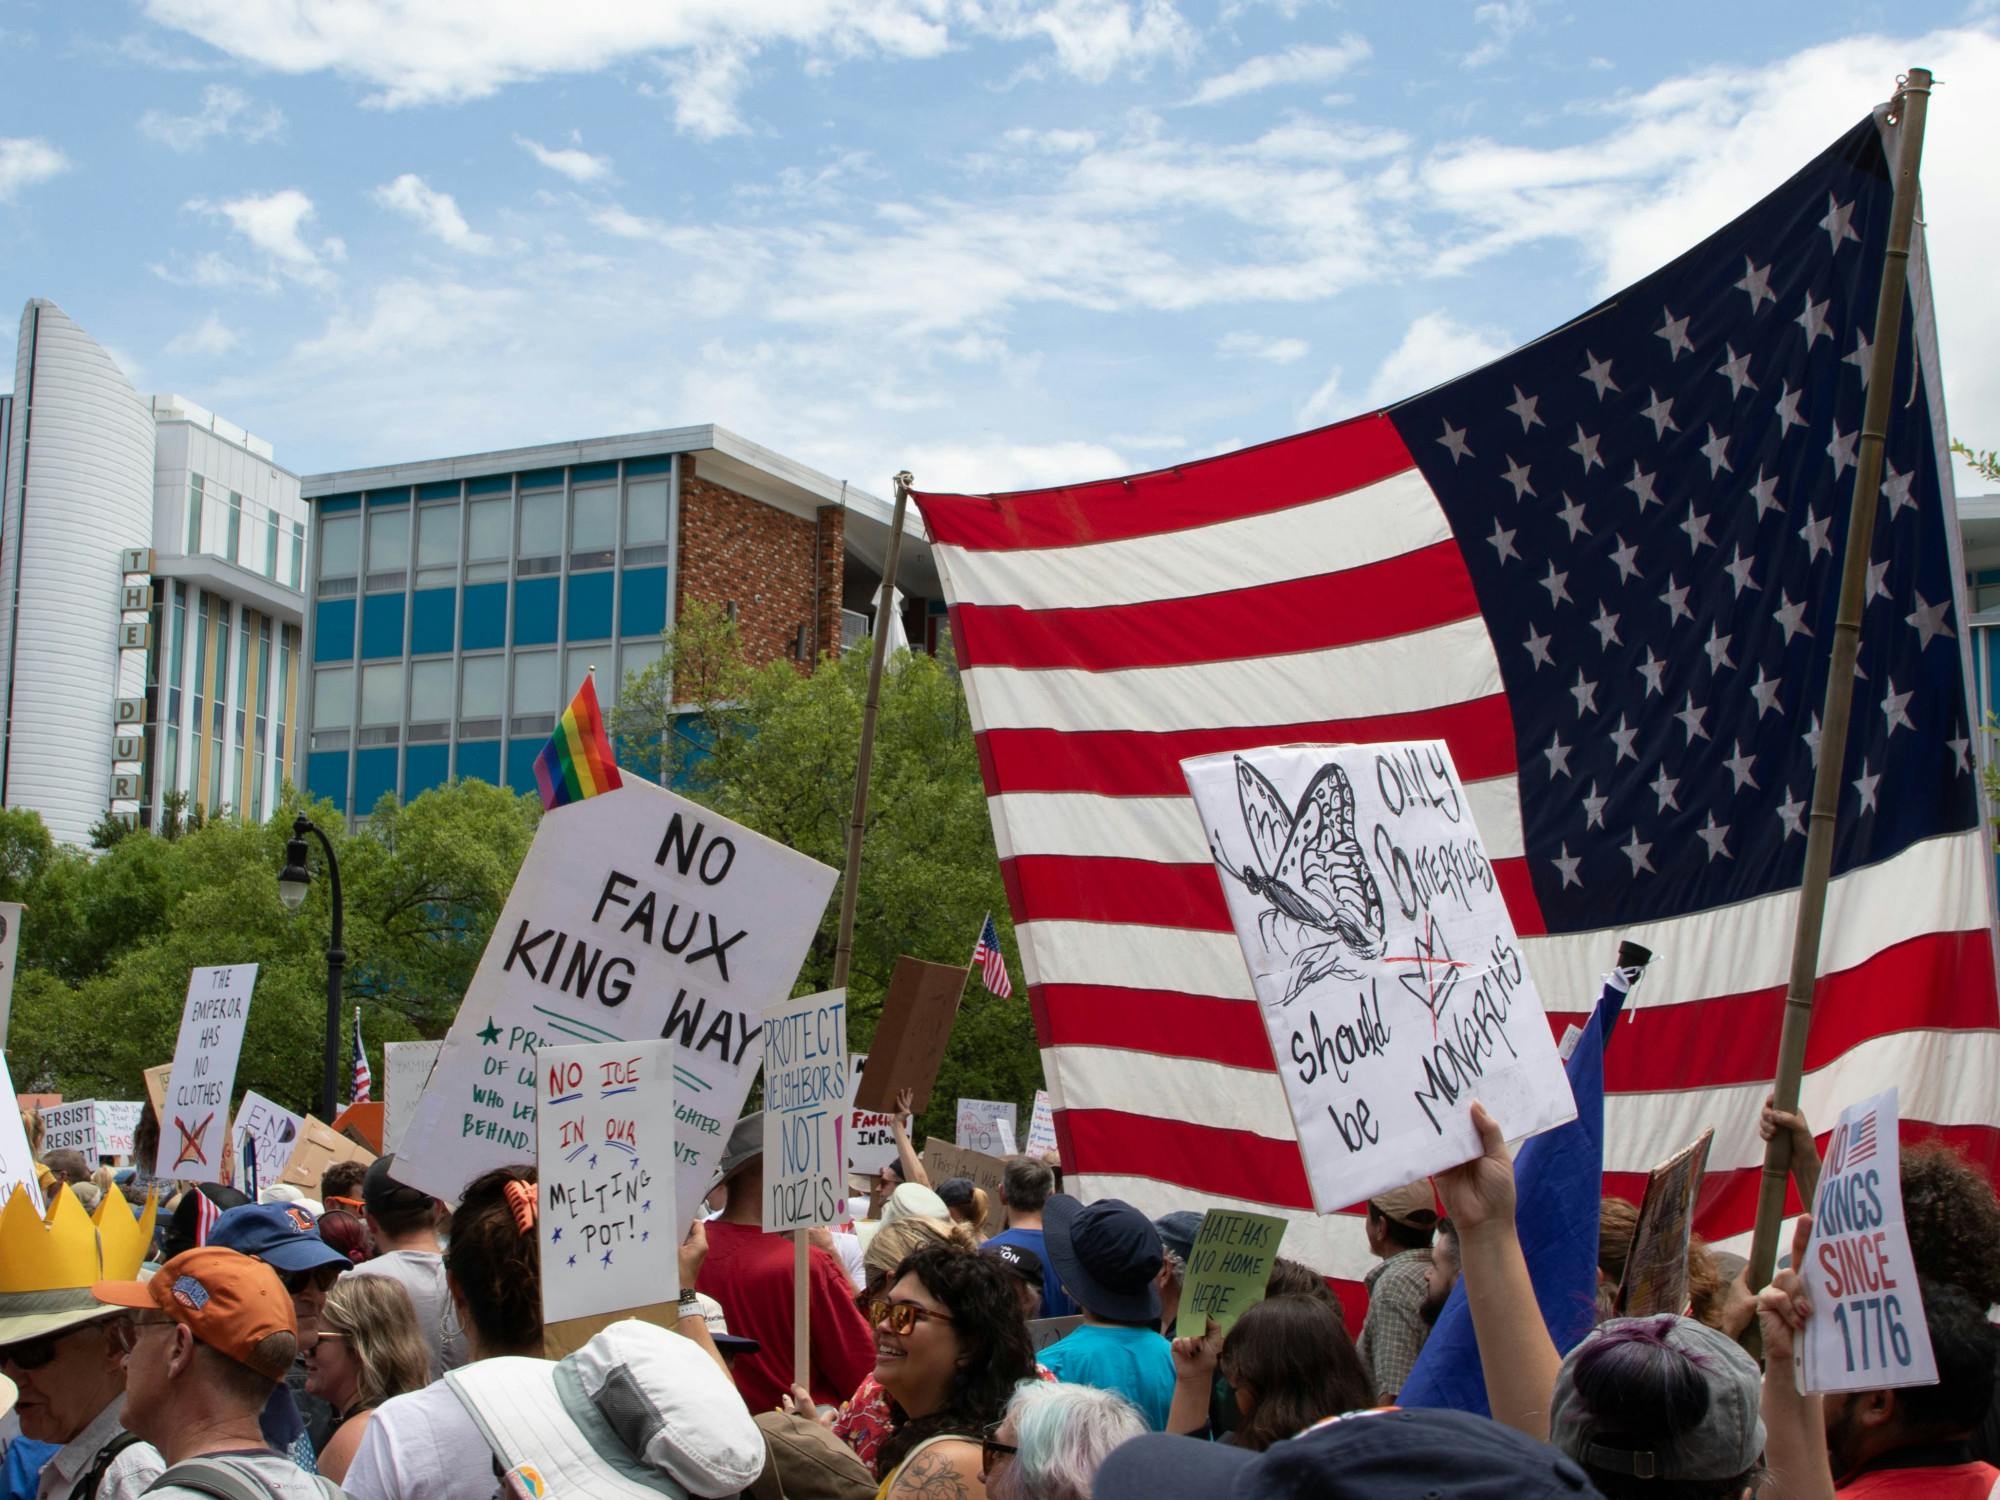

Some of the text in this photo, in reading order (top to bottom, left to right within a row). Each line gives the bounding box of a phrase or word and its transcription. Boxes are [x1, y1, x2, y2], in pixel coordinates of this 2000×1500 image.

[126, 551, 142, 645] THE
[1375, 744, 1460, 823] ONLY
[655, 812, 736, 886] NO
[592, 870, 748, 983] FAUX
[212, 968, 232, 988] THE
[503, 919, 763, 1066] KING WAY
[192, 997, 242, 1022] EMPEROR
[200, 1025, 221, 1049] HAS
[764, 1003, 844, 1071] PROTECT
[1414, 935, 1523, 1135] MONARCHS
[193, 1056, 209, 1078] NO
[484, 1056, 511, 1076] OF
[549, 1061, 583, 1097] NO
[600, 1057, 642, 1087] ICE
[176, 1080, 223, 1106] CLOTHES
[472, 1083, 505, 1108] WHO
[40, 1103, 94, 1129] ERSIST!
[246, 1104, 296, 1143] END
[559, 1115, 637, 1149] IN OUR
[1327, 1097, 1379, 1152] be
[782, 1110, 828, 1178] NOT
[857, 1131, 876, 1146] IN
[1821, 1122, 1848, 1181] NO
[549, 1169, 651, 1219] MELTING
[1815, 1168, 1883, 1238] KINGS
[579, 1214, 635, 1253] POT!
[1198, 1213, 1272, 1249] HATE HAS
[1190, 1250, 1264, 1277] NO HOME
[1818, 1231, 1897, 1299] SINCE
[1190, 1281, 1236, 1315] HERE
[1833, 1294, 1912, 1373] 1776
